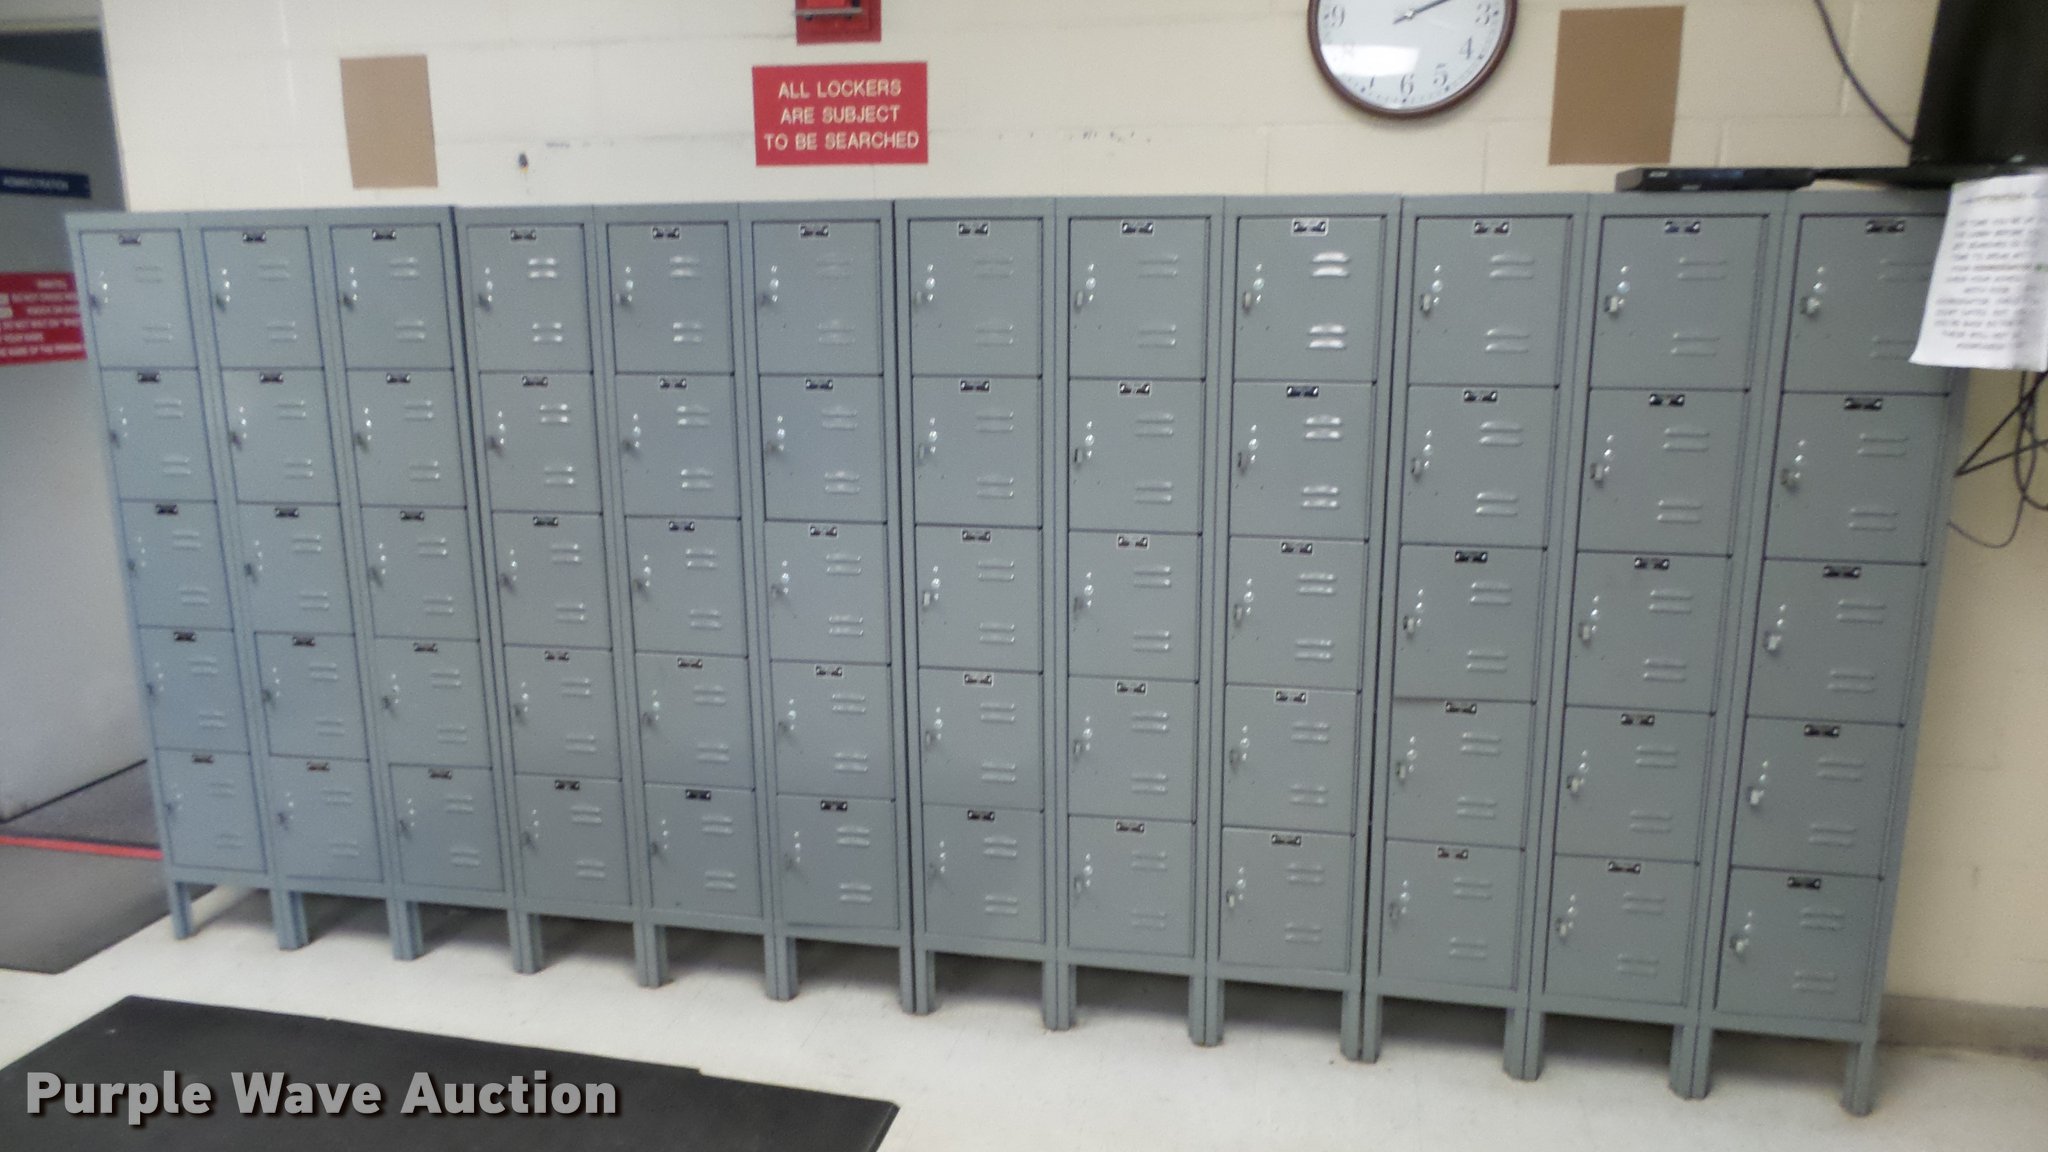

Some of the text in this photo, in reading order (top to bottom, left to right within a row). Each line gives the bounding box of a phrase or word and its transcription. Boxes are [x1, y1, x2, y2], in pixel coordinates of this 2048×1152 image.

[1331, 5, 1345, 27] 9
[1475, 2, 1491, 25] 3
[1458, 35, 1473, 60] 4
[1400, 73, 1414, 95] 6
[1433, 62, 1448, 86] 5
[778, 78, 902, 99] ALL LOCKERS
[780, 104, 901, 125] ARE SUBJECT
[764, 130, 920, 151] TO BE SEARCHED
